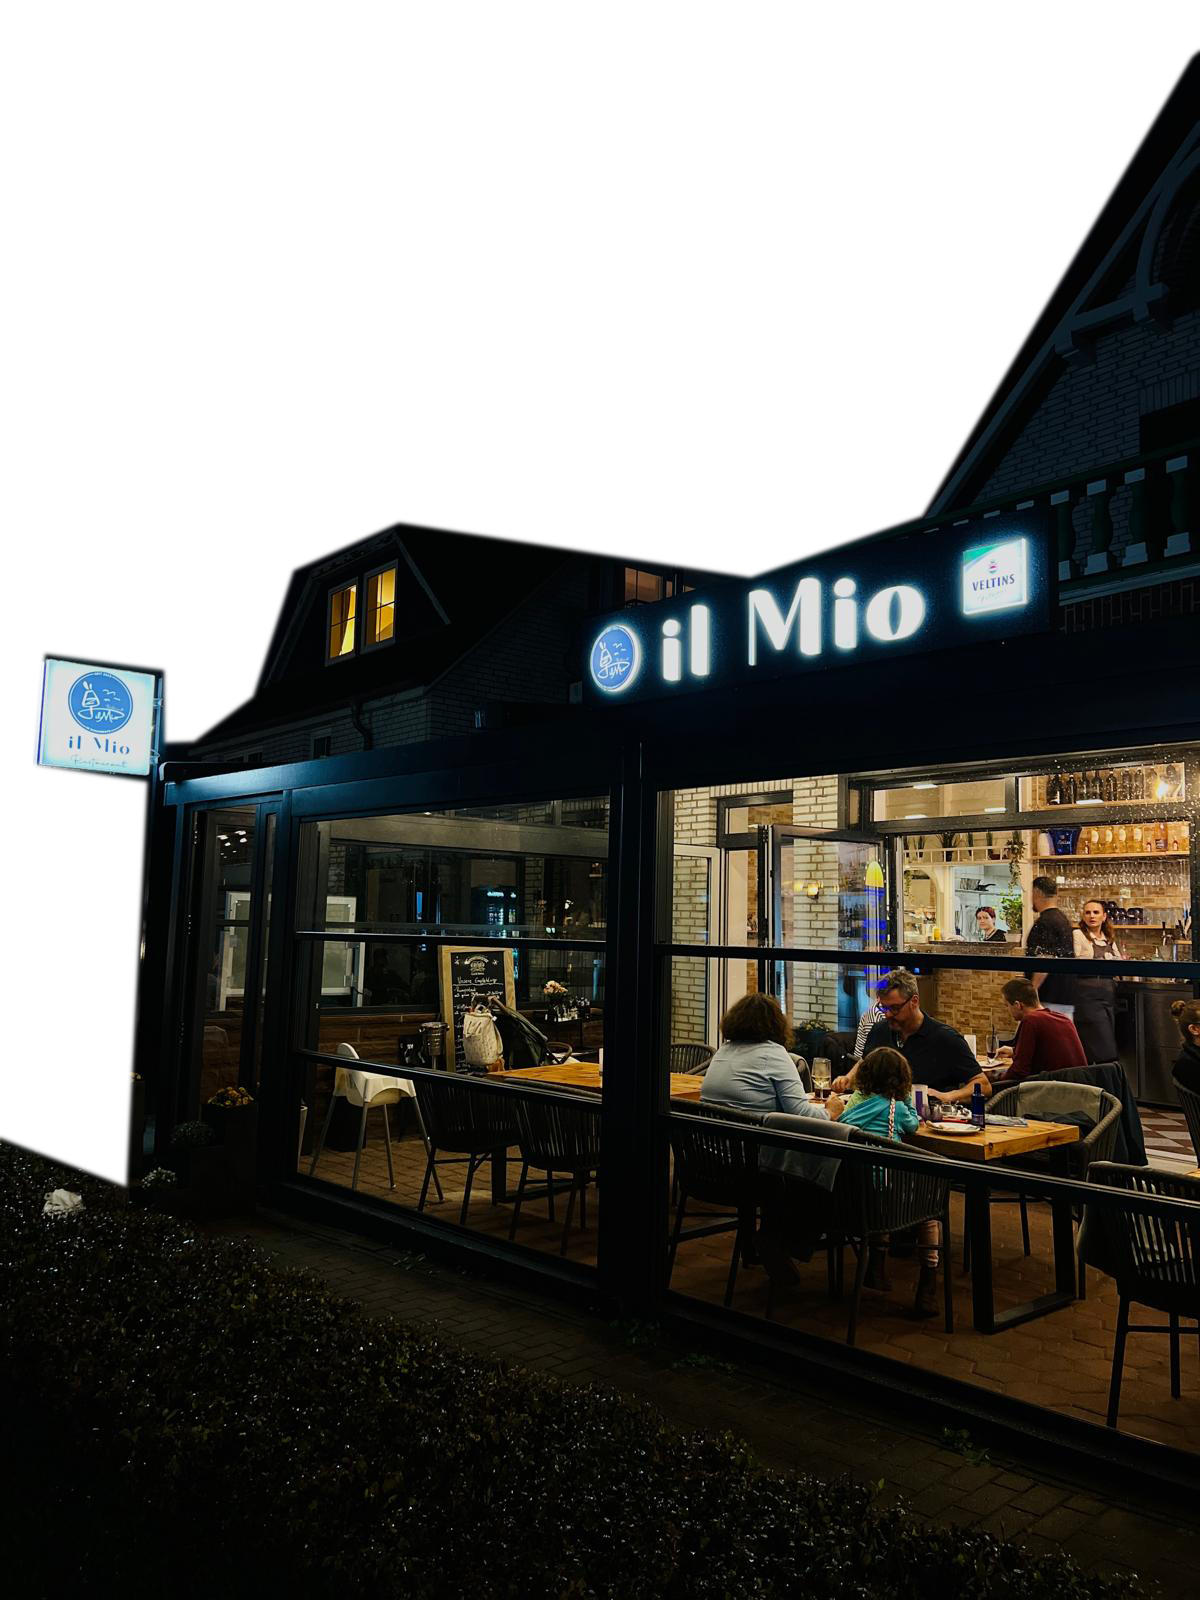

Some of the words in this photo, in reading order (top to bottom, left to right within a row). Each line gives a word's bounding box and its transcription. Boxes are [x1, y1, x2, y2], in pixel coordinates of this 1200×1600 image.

[972, 573, 1015, 591] VELTINS
[661, 604, 711, 682] il
[748, 577, 926, 667] Mio
[68, 735, 82, 749] il
[93, 737, 130, 755] Mio
